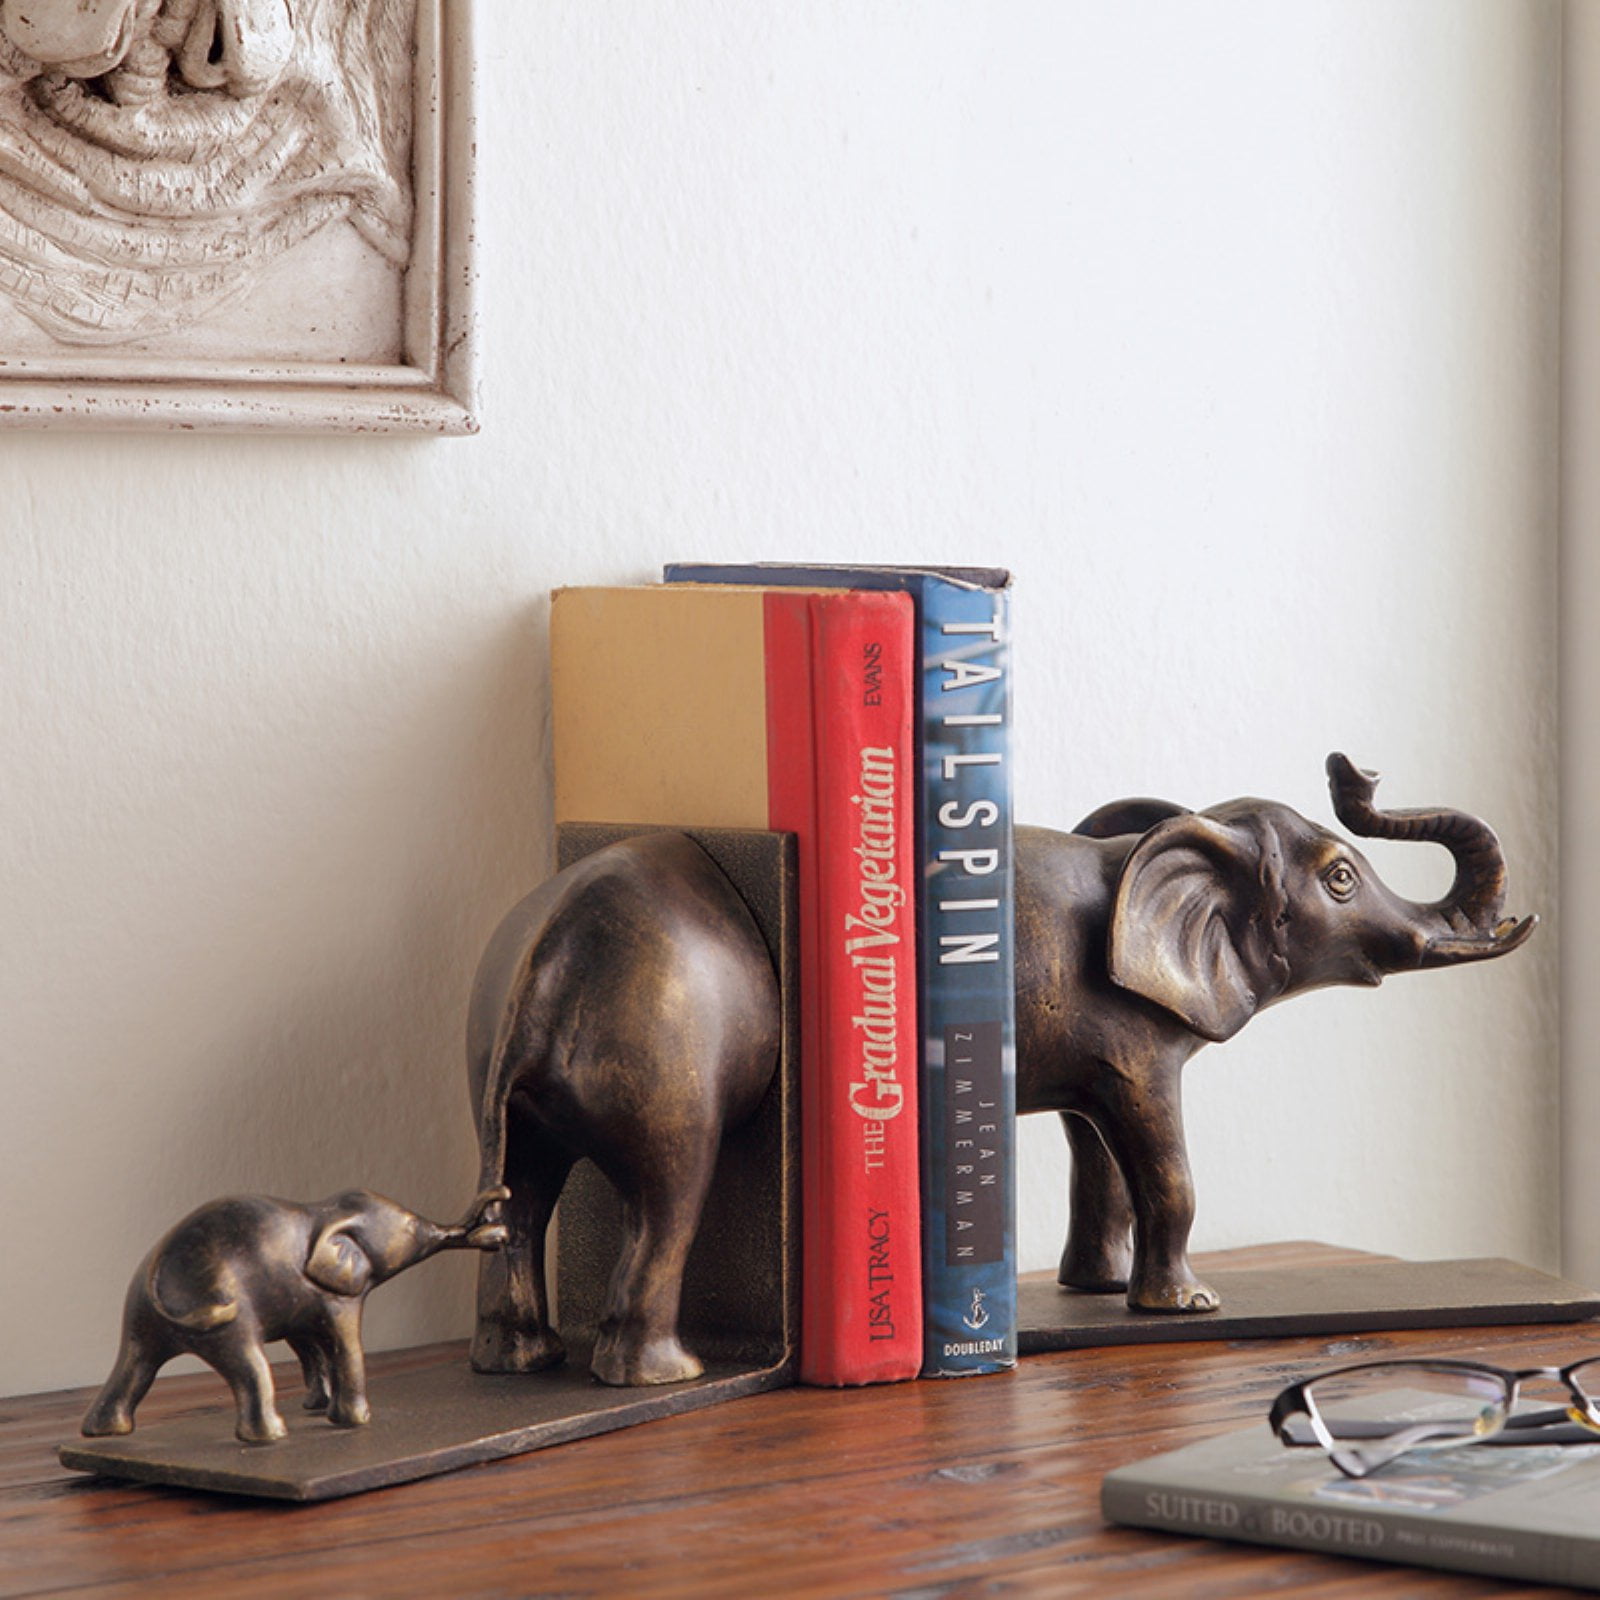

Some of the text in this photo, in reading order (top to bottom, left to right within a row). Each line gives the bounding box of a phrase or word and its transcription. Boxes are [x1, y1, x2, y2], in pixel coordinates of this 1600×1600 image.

[863, 642, 883, 707] EVANS
[938, 614, 1002, 966] TAILSPIN
[847, 746, 906, 1174] THE Gradual Vegetarian
[954, 1032, 975, 1257] ZIMMERMAN
[979, 1101, 997, 1185] JEAN
[866, 1209, 895, 1343] LISA TRACY
[944, 1338, 1004, 1357] DOUBLEDAY
[1145, 1494, 1239, 1528] SUITED
[1272, 1510, 1385, 1547] BOOTED
